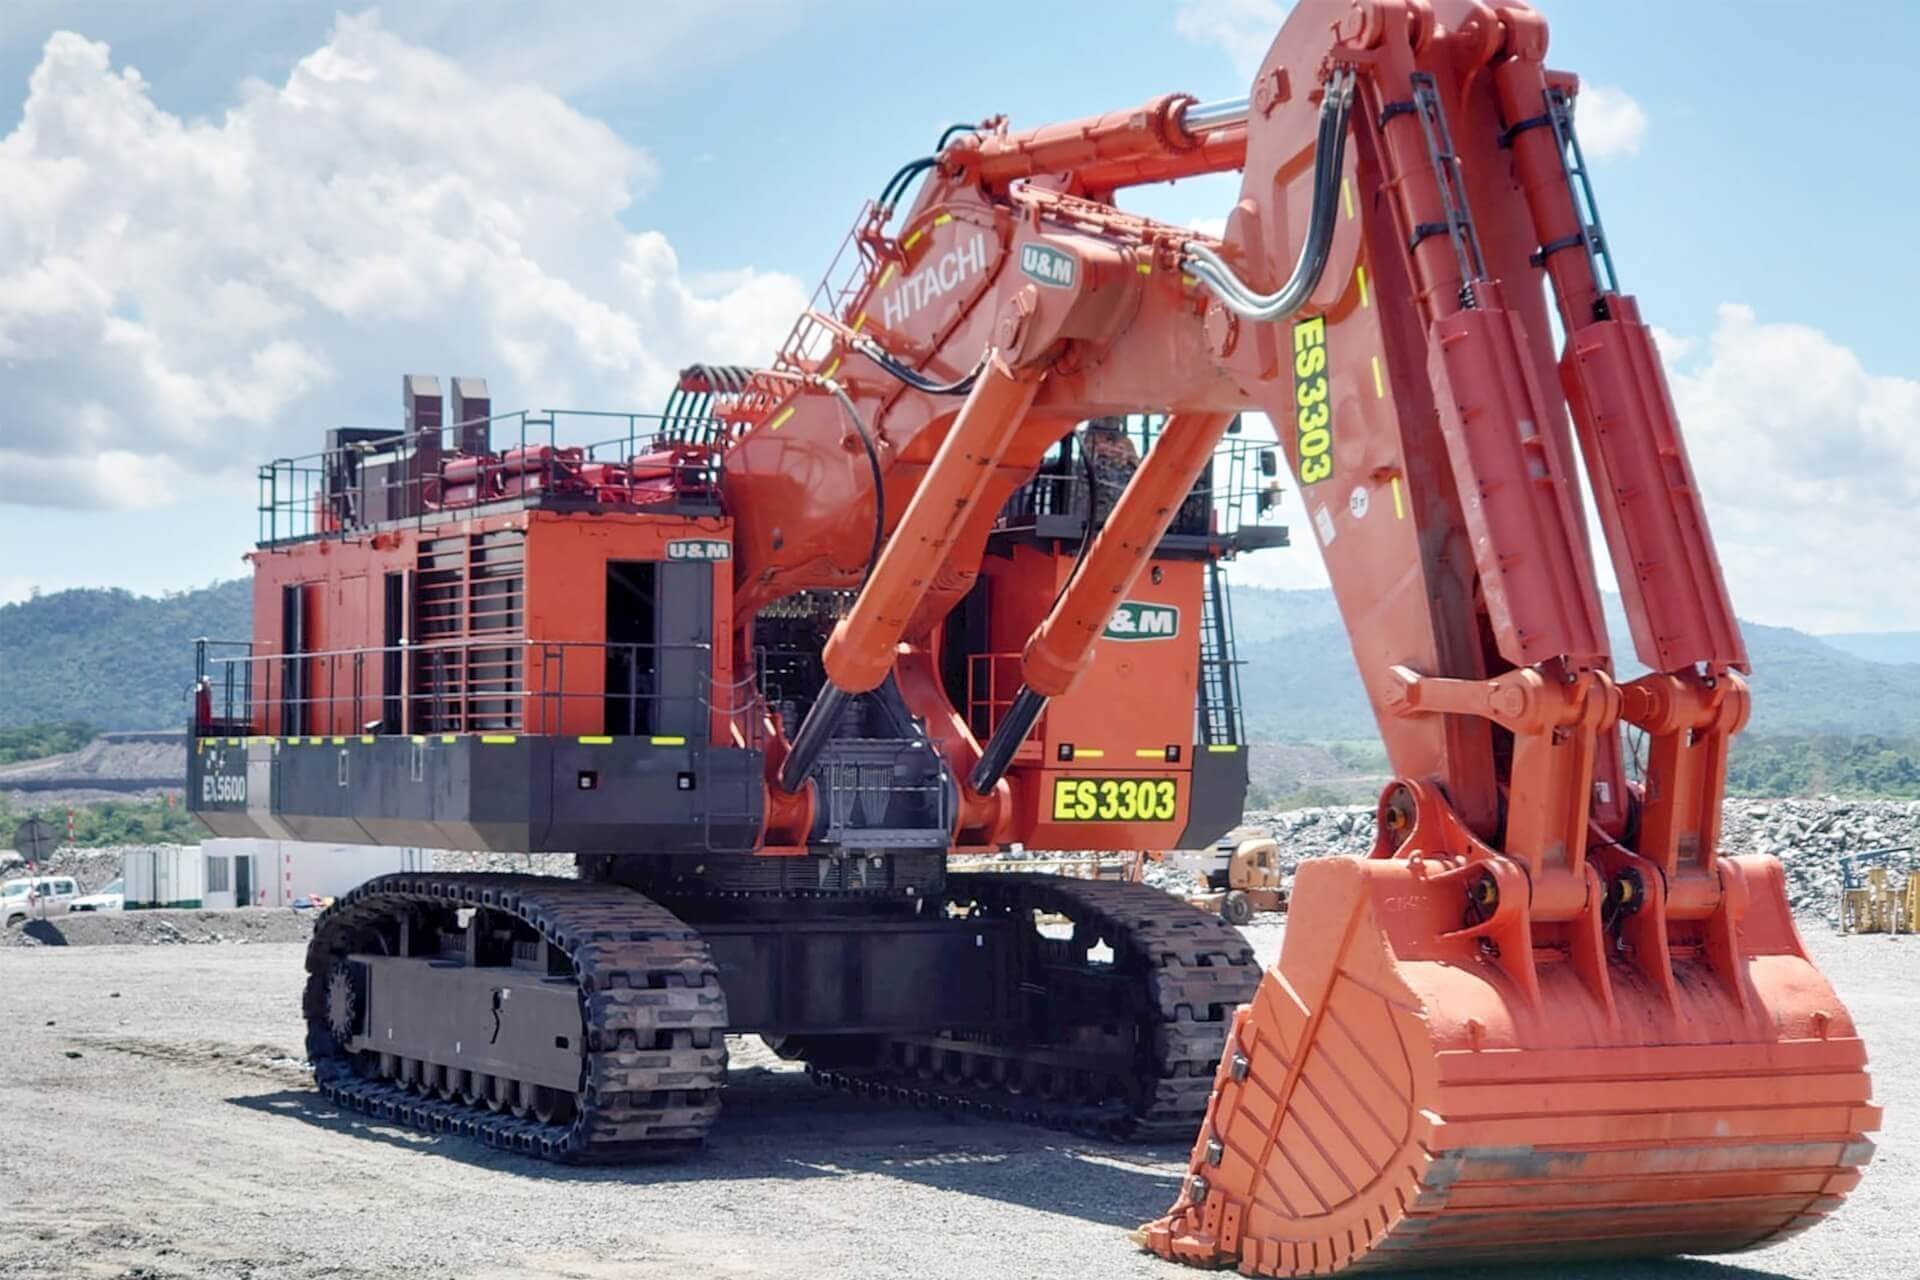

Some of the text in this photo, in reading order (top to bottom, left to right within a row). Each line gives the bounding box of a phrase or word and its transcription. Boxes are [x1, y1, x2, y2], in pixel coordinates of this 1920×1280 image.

[1022, 247, 1073, 284] U&M
[881, 233, 987, 331] HITACHI
[669, 543, 729, 558] U&M
[1108, 609, 1173, 633] &M
